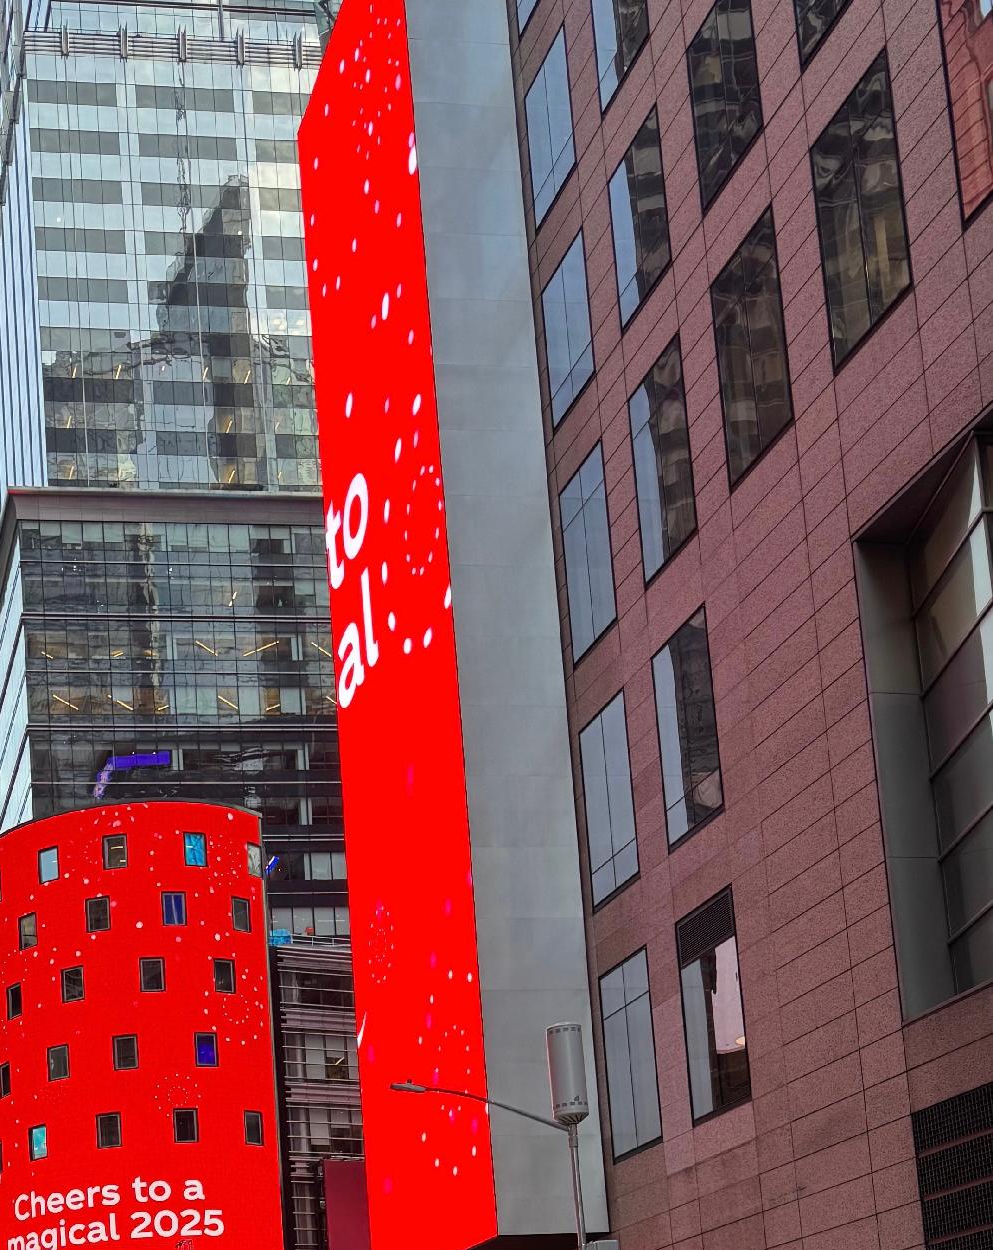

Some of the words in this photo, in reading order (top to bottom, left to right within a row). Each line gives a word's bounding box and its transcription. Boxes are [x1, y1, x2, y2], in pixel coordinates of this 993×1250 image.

[325, 473, 368, 589] to
[14, 1183, 121, 1221] Cheers
[131, 1175, 172, 1202] to
[183, 1179, 206, 1201] a
[130, 1209, 225, 1239] 2025
